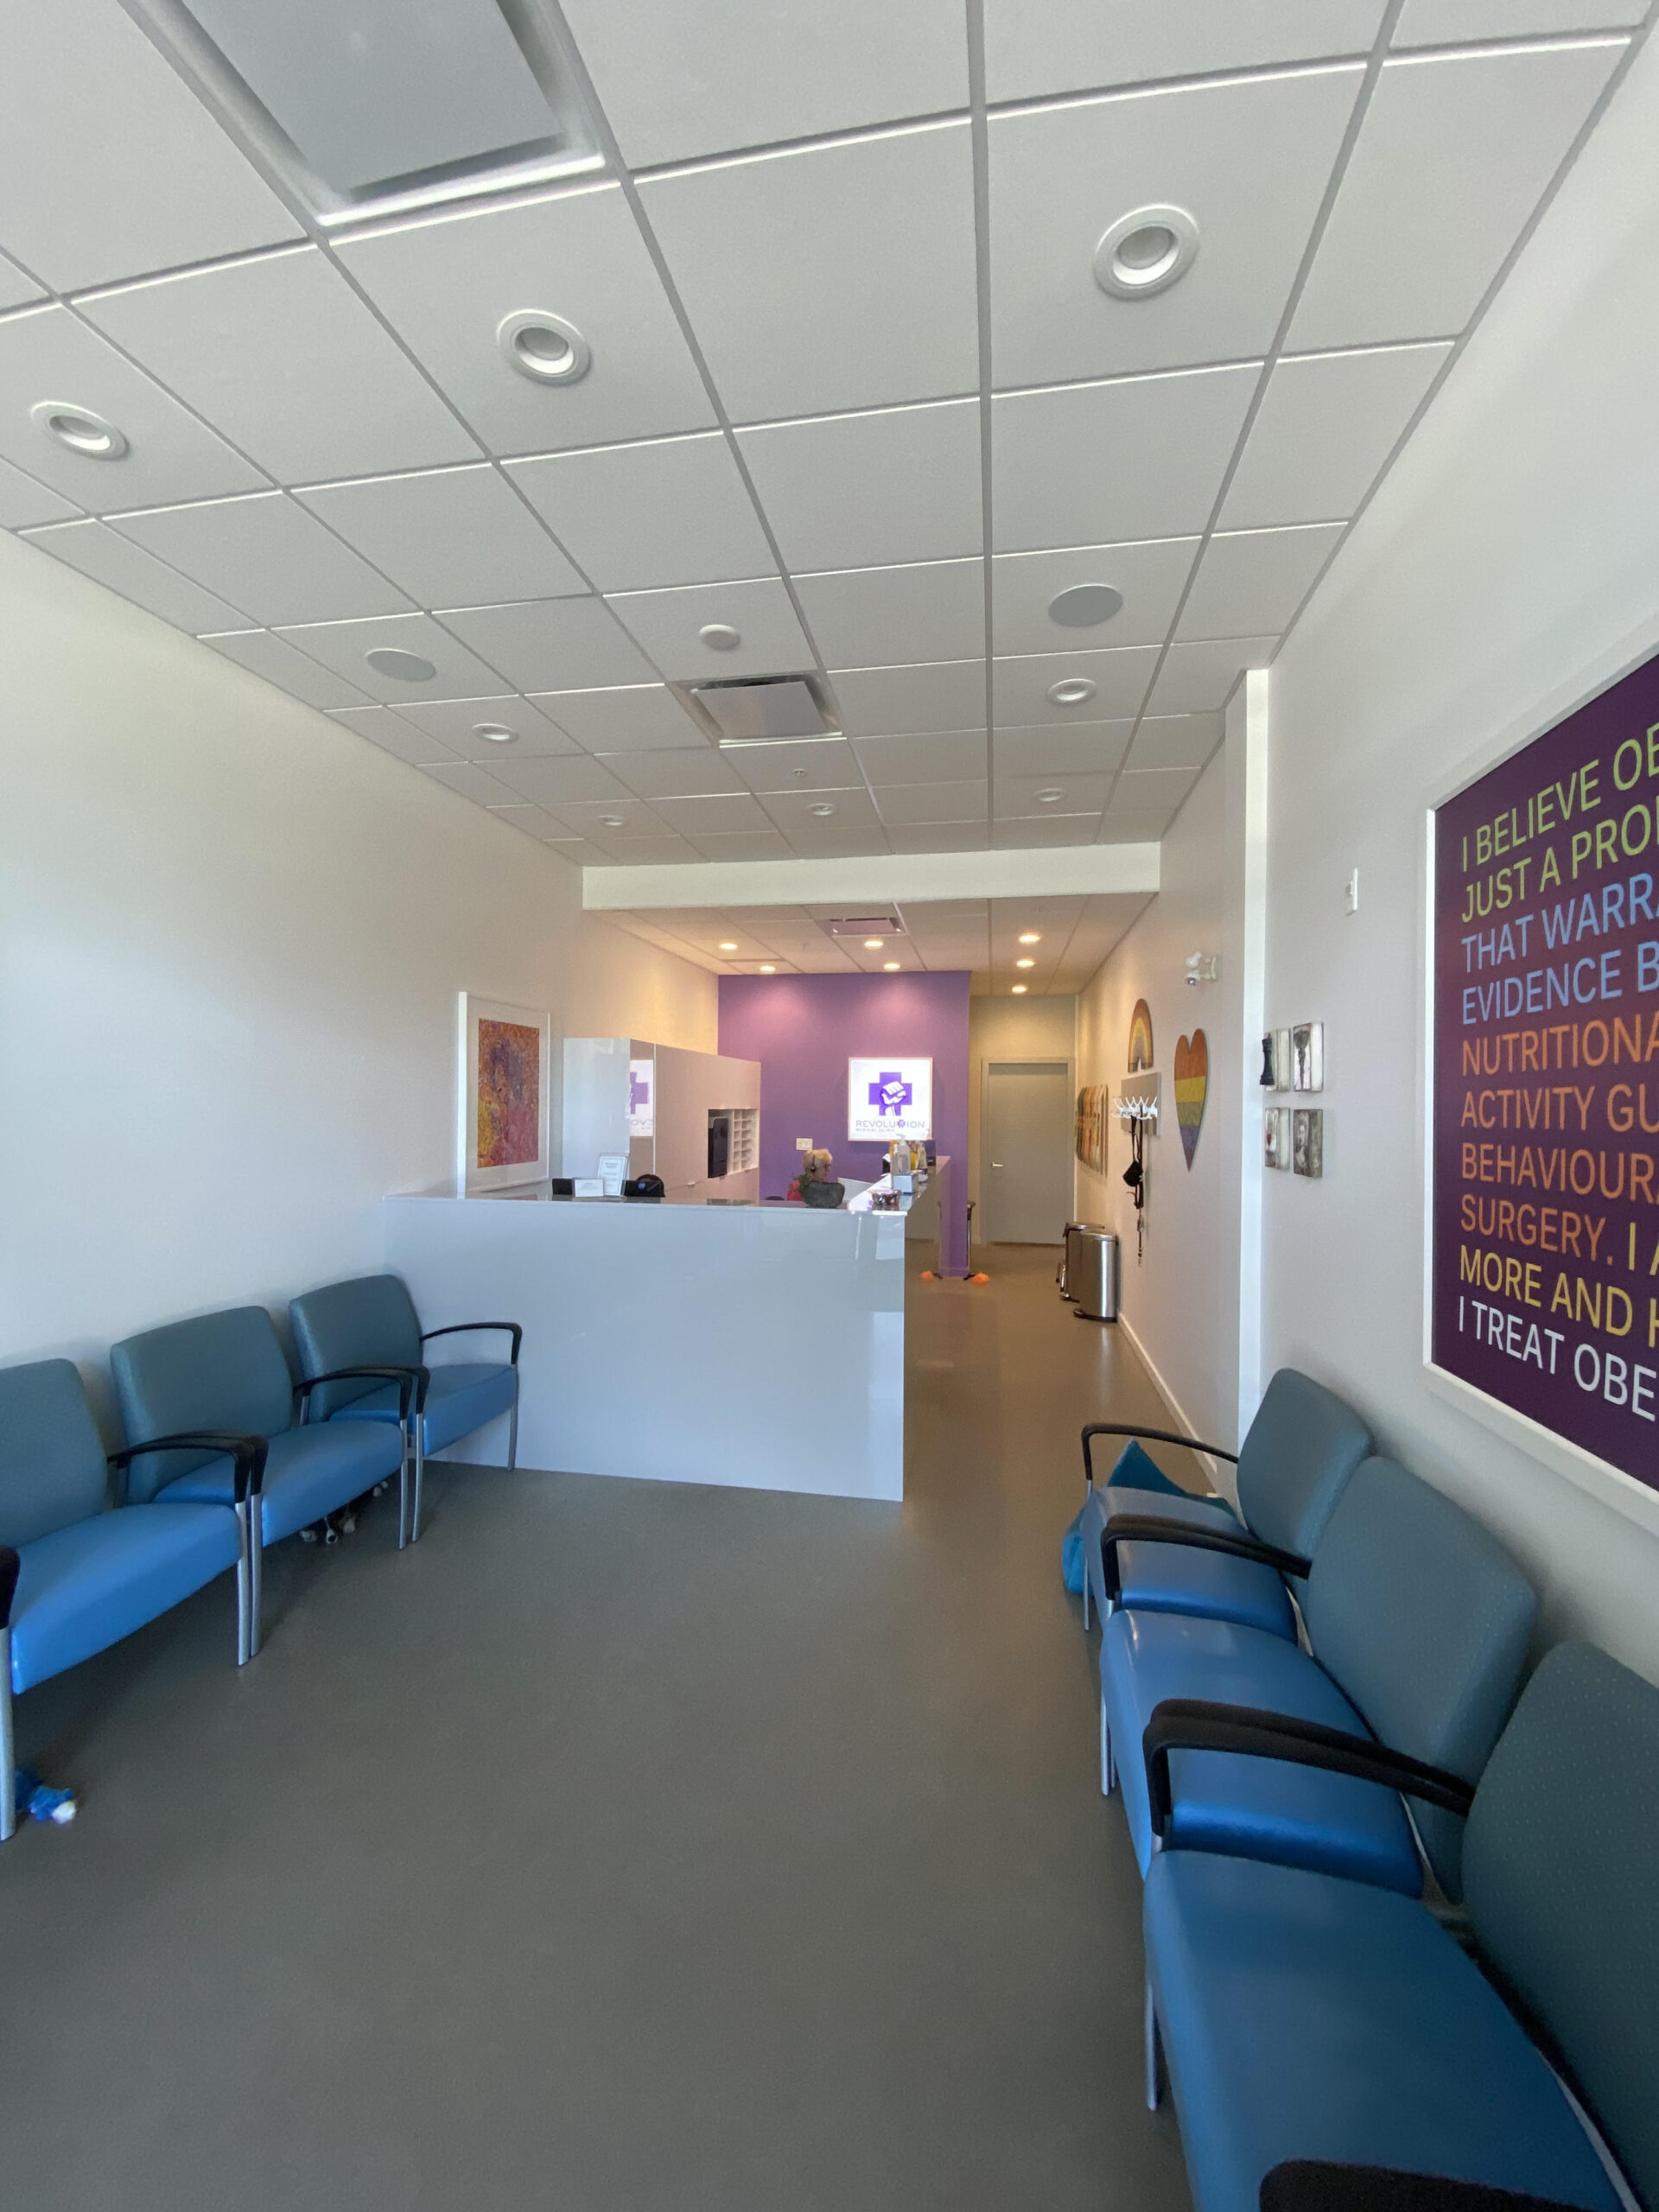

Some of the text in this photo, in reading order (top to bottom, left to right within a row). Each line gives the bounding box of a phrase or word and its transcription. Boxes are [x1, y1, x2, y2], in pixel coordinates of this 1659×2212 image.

[1461, 795, 1659, 923] JUST A PRO
[1462, 836, 1468, 873] I
[1475, 760, 1601, 865] BELIEVE
[1461, 873, 1659, 974] THAT WARR
[1462, 950, 1623, 1026] EVIDENCE
[1461, 1085, 1595, 1131] ACTIVITY
[1462, 1142, 1659, 1205] BEHAVIOUR
[1461, 1193, 1613, 1266] SURGERY.
[1629, 1222, 1637, 1271] I
[1460, 1244, 1542, 1307] MORE
[1551, 1272, 1633, 1337] AND
[1459, 1296, 1465, 1332] I
[1471, 1300, 1565, 1375] TREAT
[1573, 1344, 1657, 1422] OBE
